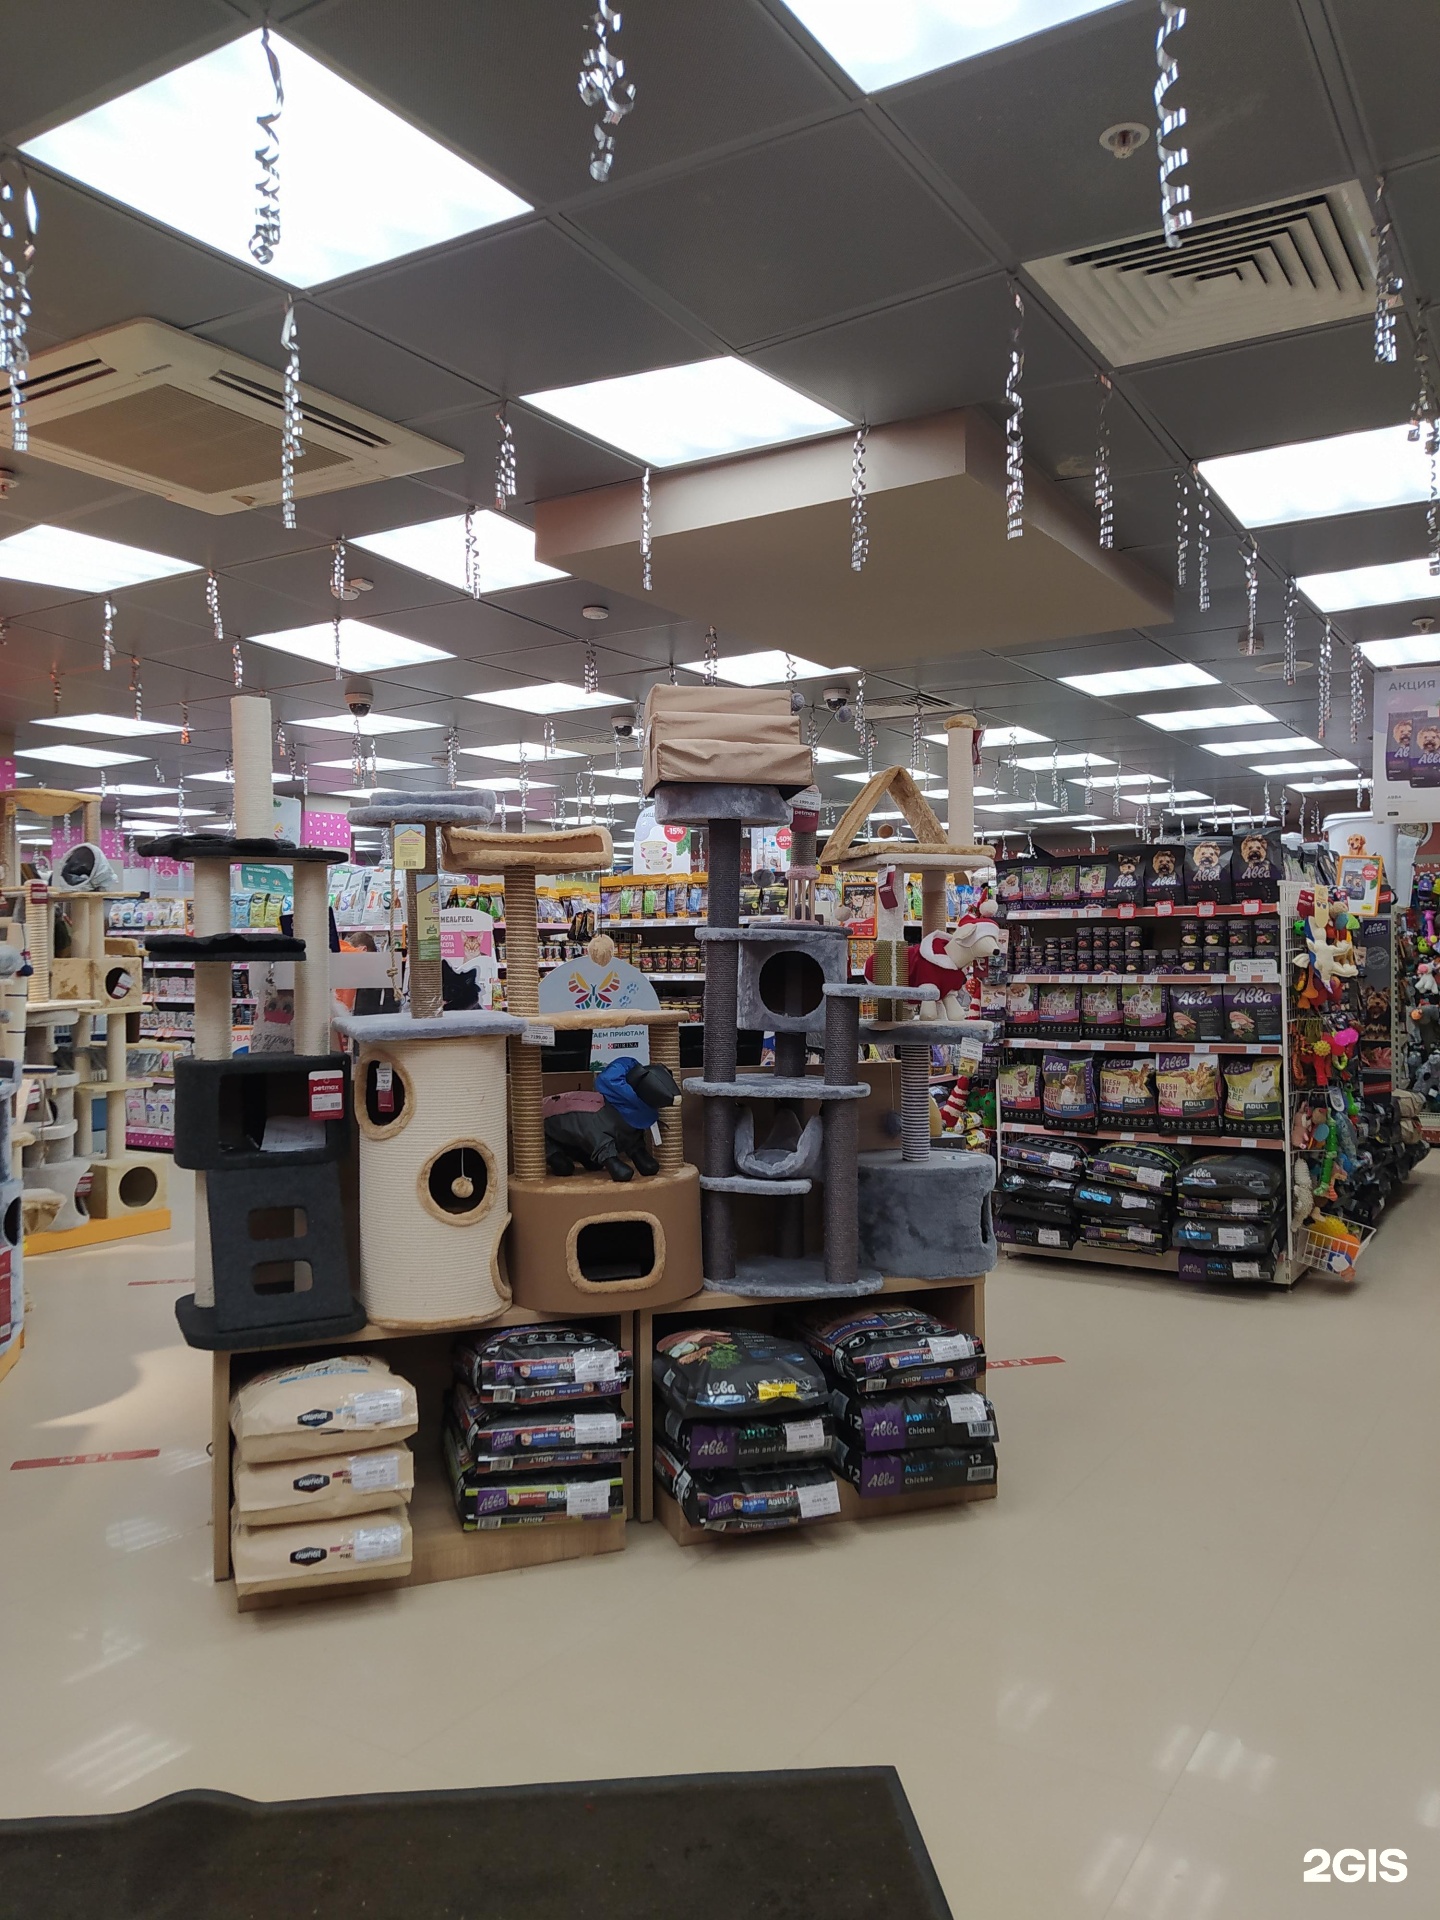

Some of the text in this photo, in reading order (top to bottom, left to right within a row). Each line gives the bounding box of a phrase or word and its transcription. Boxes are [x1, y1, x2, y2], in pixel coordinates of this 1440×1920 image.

[1388, 680, 1436, 691] АКЦИЯ
[666, 827, 684, 835] -15%
[609, 1030, 645, 1038] ПРИЮТАМ
[313, 1085, 339, 1093] petmax
[530, 1389, 555, 1398] ADULT
[908, 1426, 936, 1435] Chicken
[738, 1446, 760, 1455] Lamb
[761, 1445, 776, 1453] and
[968, 1454, 982, 1464] 12
[848, 1465, 861, 1483] 12
[904, 1476, 934, 1484] Chicken
